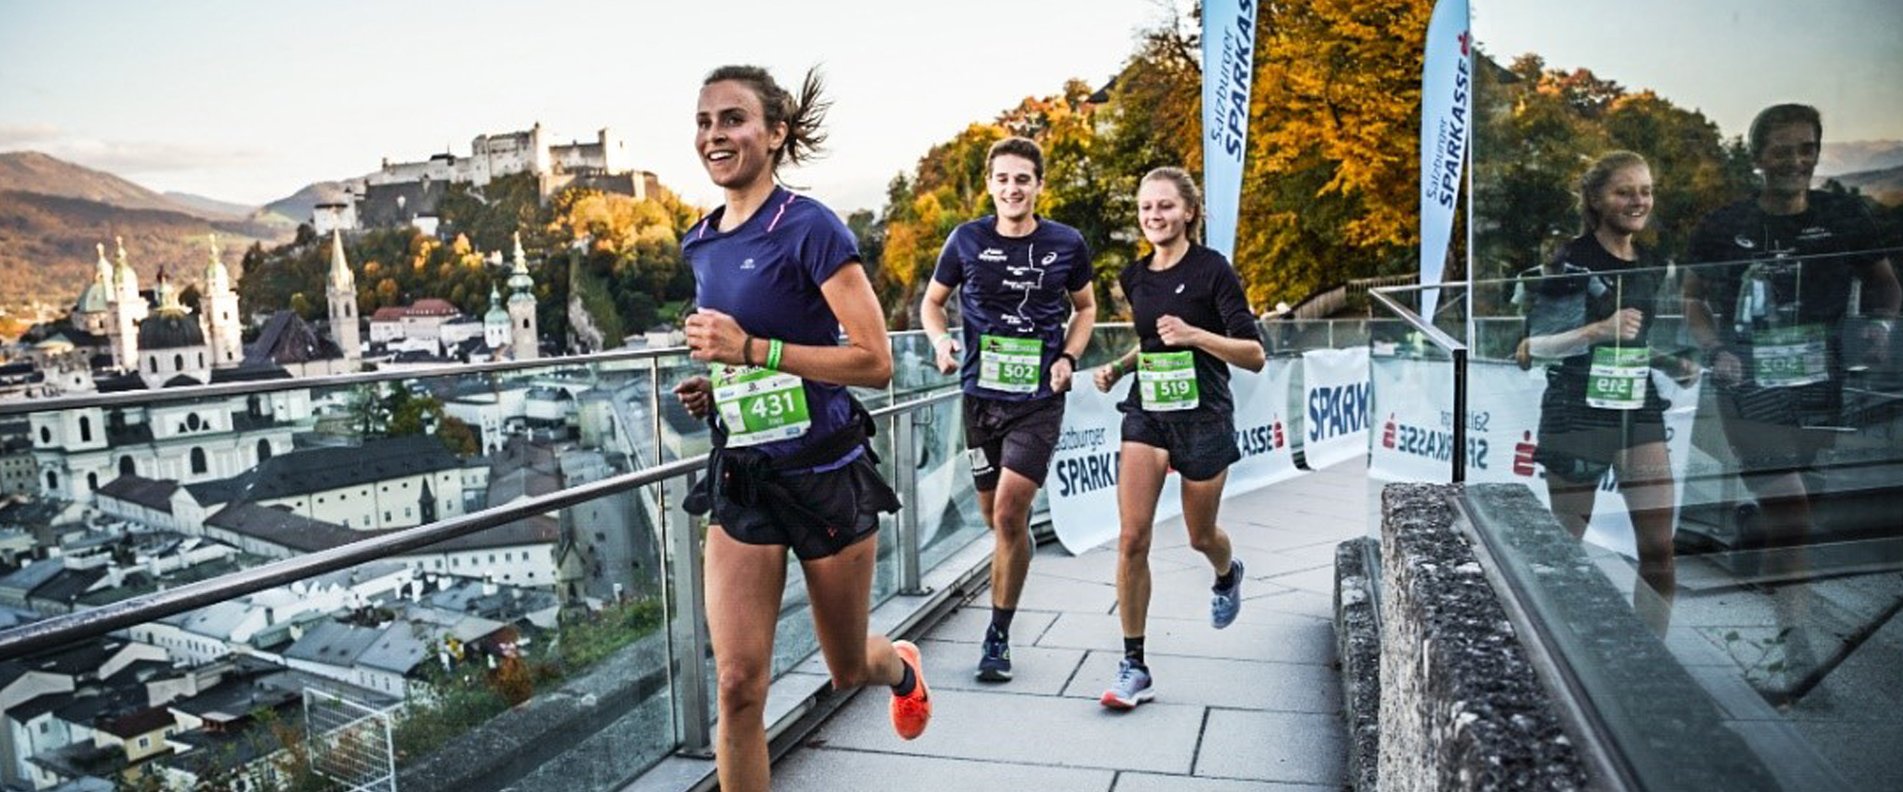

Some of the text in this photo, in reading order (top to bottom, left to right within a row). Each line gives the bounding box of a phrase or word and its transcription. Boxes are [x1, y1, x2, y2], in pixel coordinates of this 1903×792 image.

[1210, 25, 1234, 147] Salzburger
[1426, 116, 1448, 201] Salzburger
[1439, 57, 1469, 211] SPARKASSE
[1003, 364, 1035, 379] 502
[1160, 379, 1190, 397] 519
[750, 391, 795, 418] 431
[1308, 381, 1370, 443] SPARK
